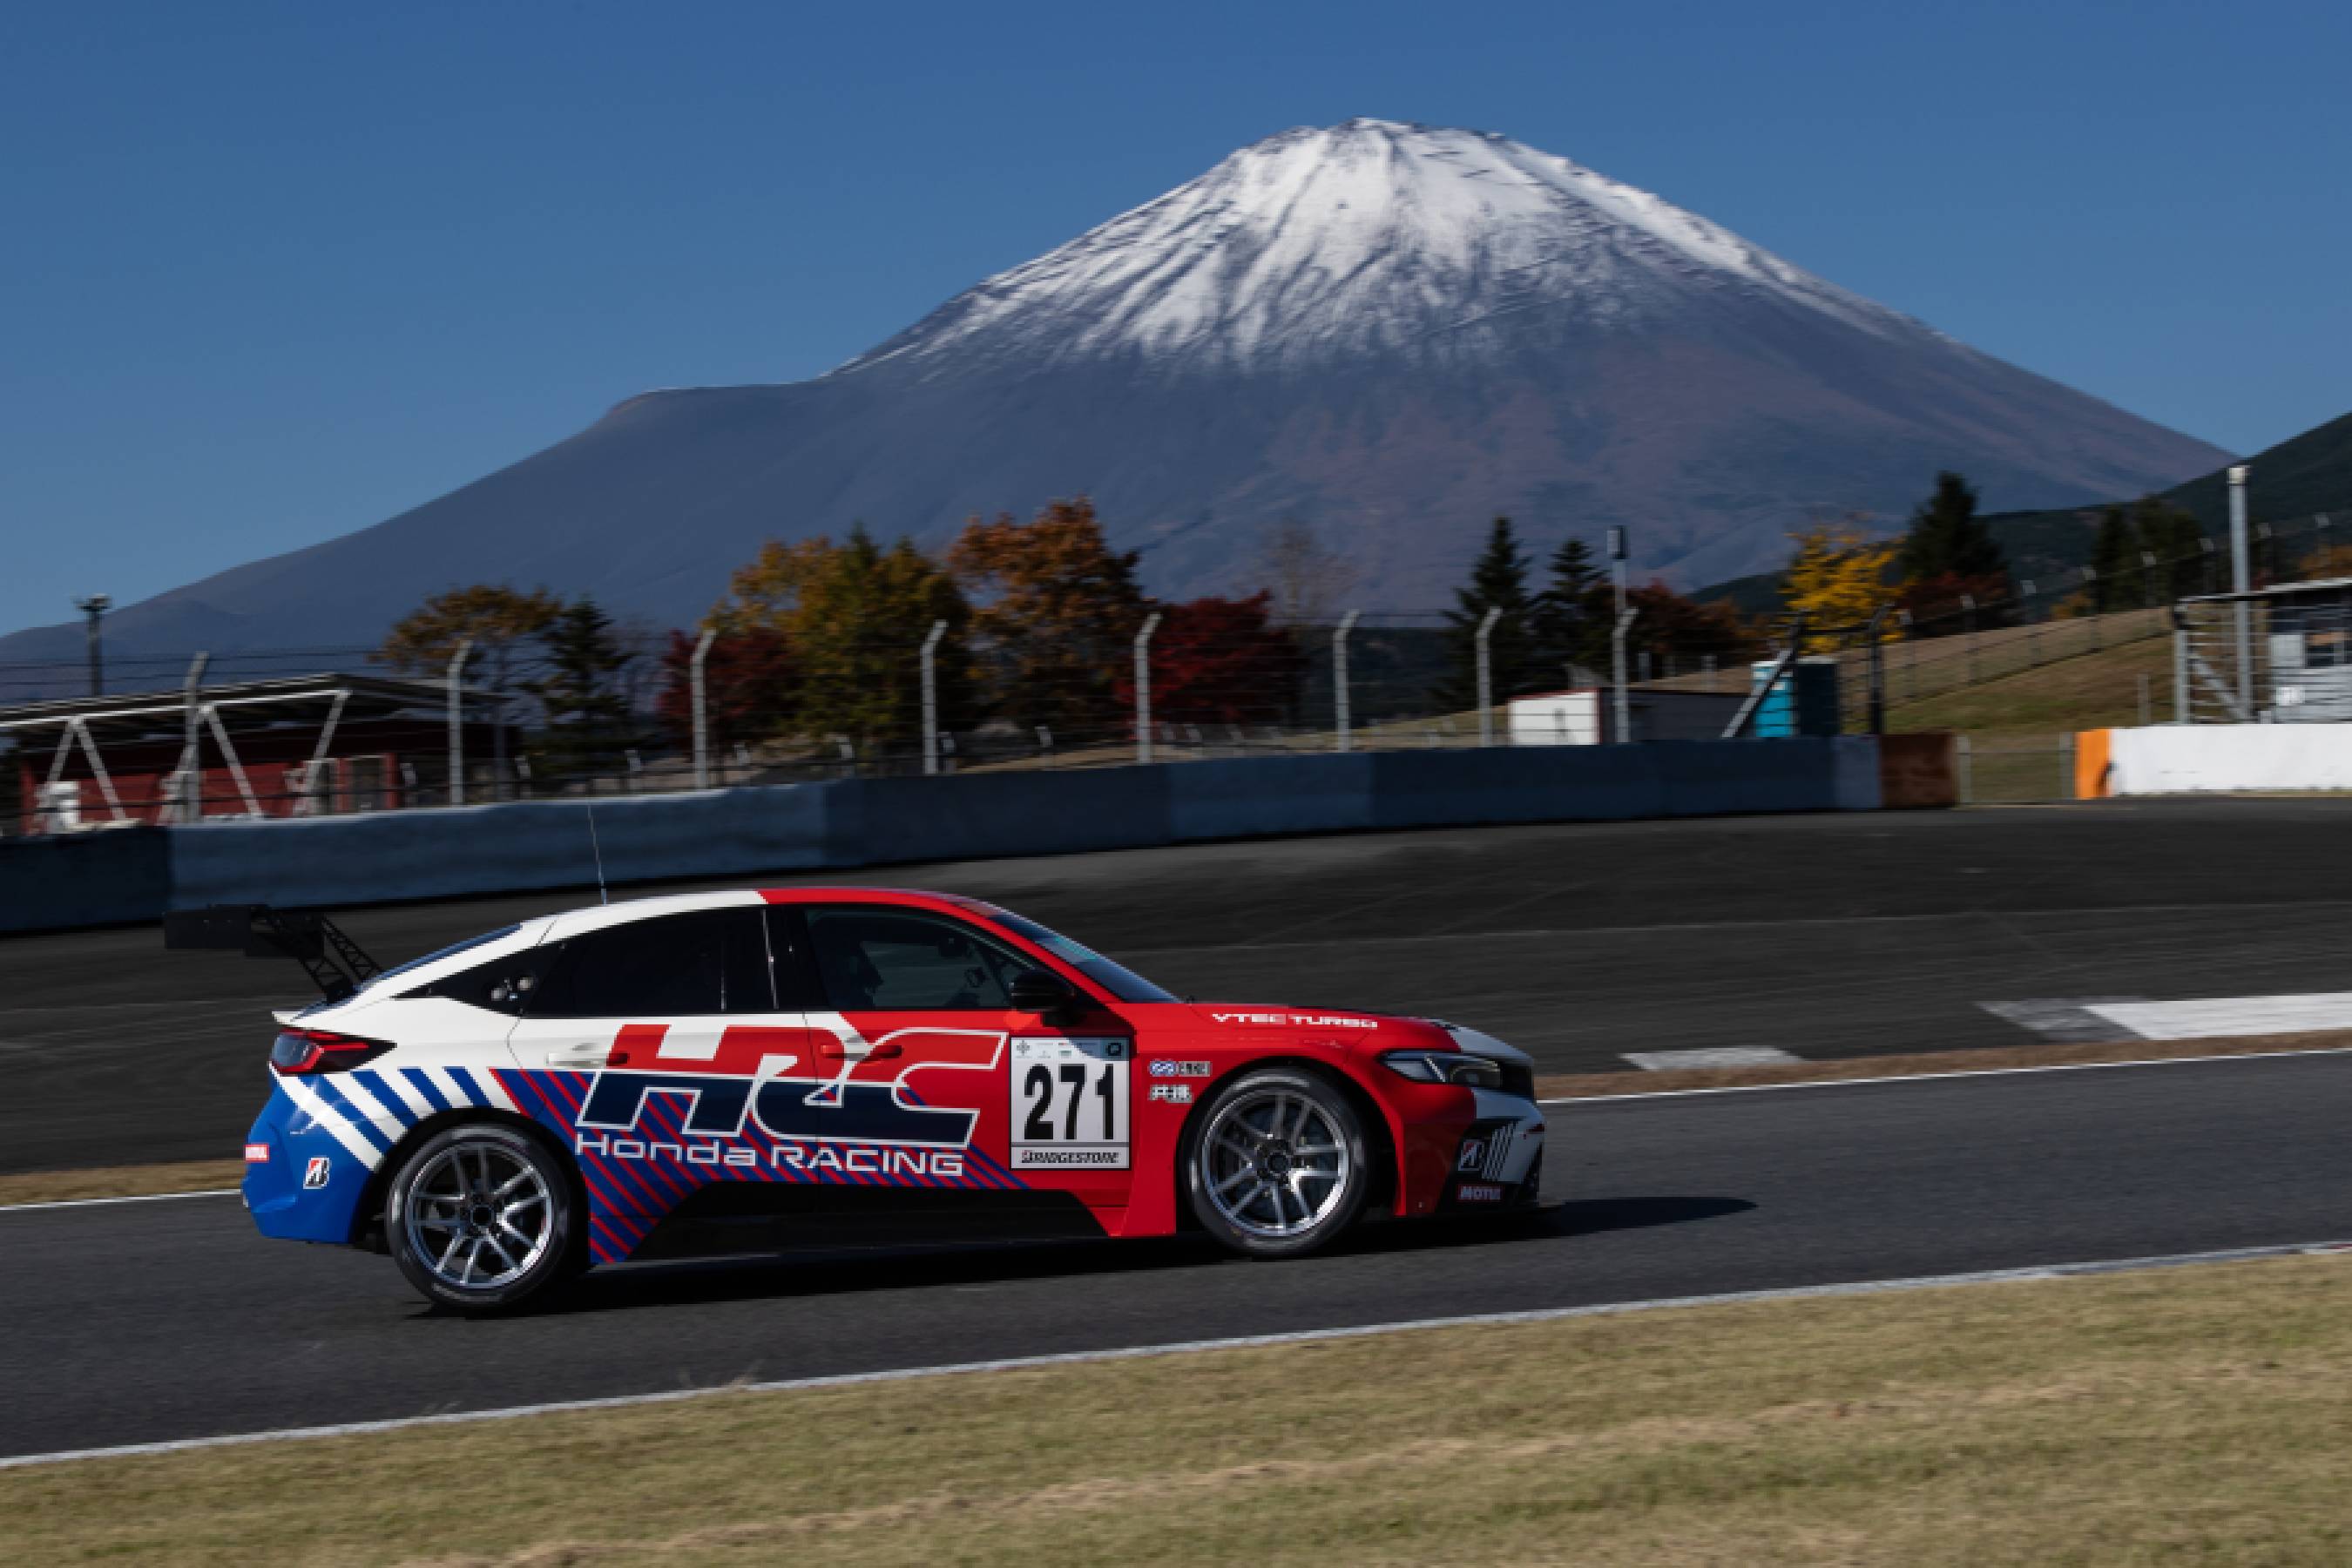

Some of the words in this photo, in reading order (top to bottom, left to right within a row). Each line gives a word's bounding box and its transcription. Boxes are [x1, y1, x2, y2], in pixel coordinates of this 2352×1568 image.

[1212, 1013, 1286, 1025] VTEC
[1289, 1014, 1378, 1030] TURBO
[1024, 1064, 1114, 1140] 271
[575, 1134, 756, 1166] Honda
[771, 1144, 963, 1176] RACING
